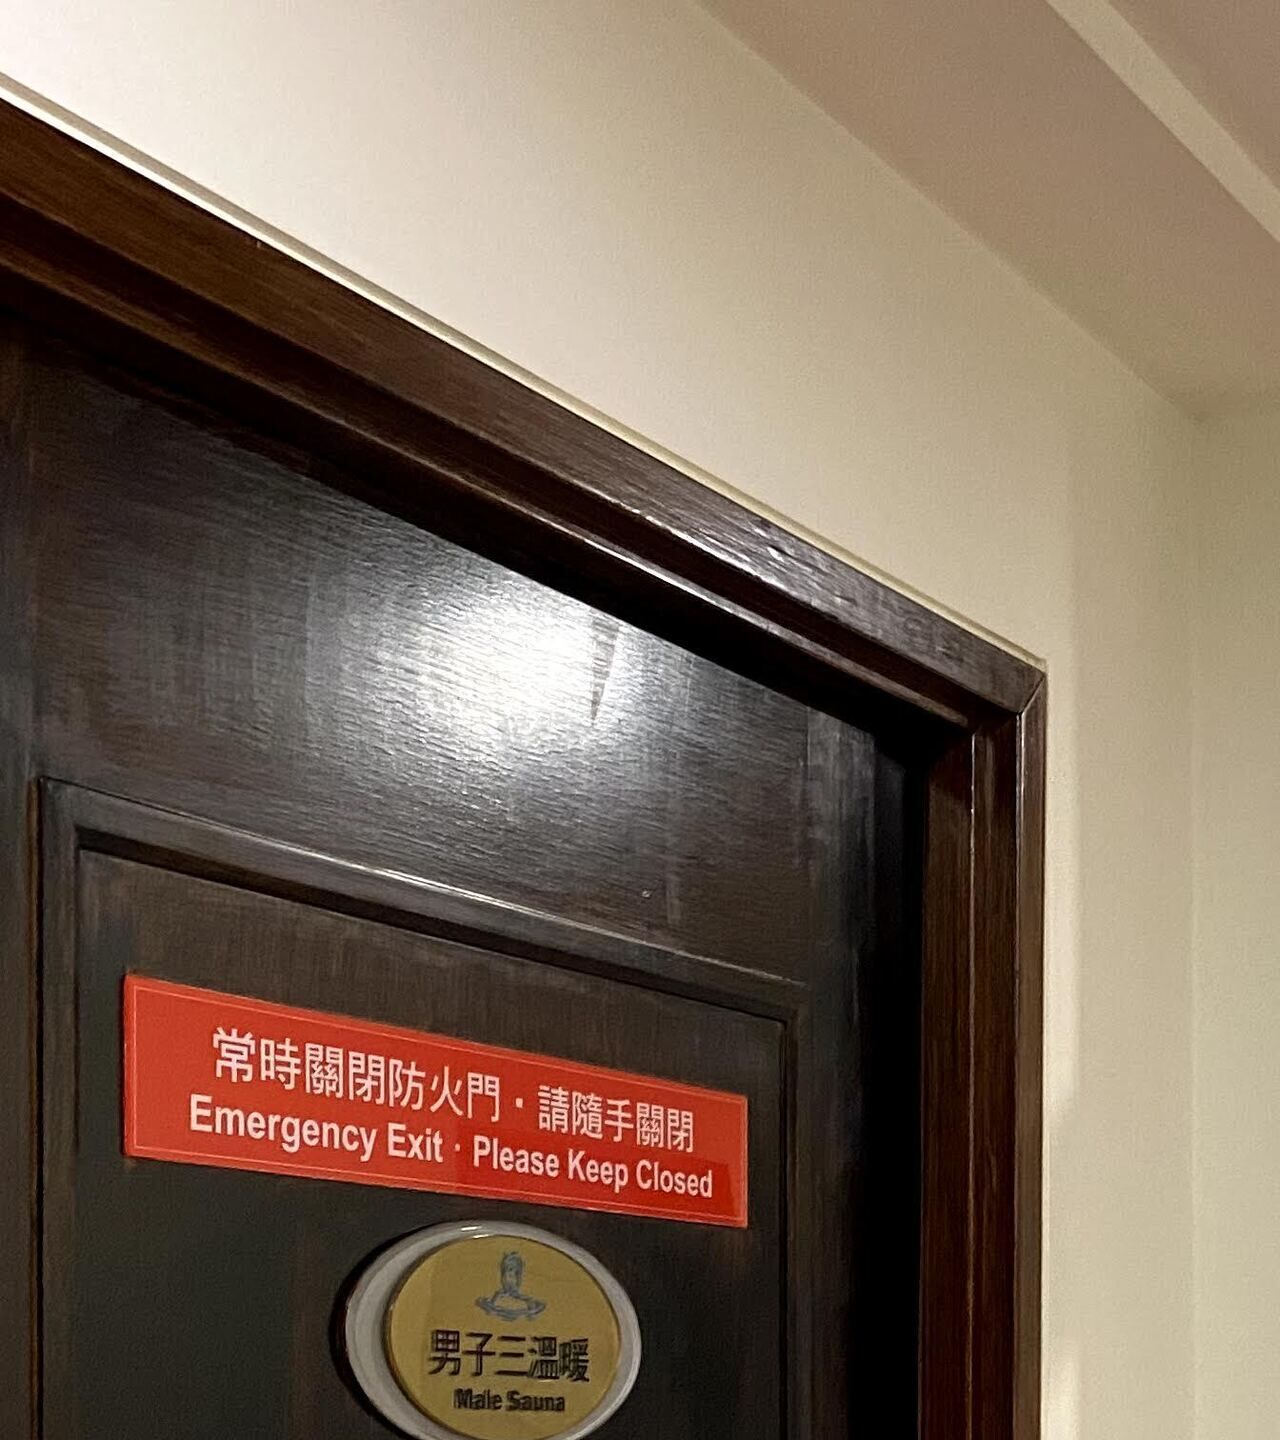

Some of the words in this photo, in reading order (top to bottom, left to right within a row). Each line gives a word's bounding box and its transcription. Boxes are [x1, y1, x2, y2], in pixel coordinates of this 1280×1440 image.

[190, 1094, 376, 1160] Emergency
[387, 1128, 443, 1162] Exit
[473, 1136, 559, 1178] Please
[567, 1150, 629, 1192] Keep
[636, 1160, 713, 1198] Closed
[428, 1329, 590, 1382] 男子三溫暖
[453, 1388, 502, 1410] Male
[506, 1390, 565, 1412] Sauna
